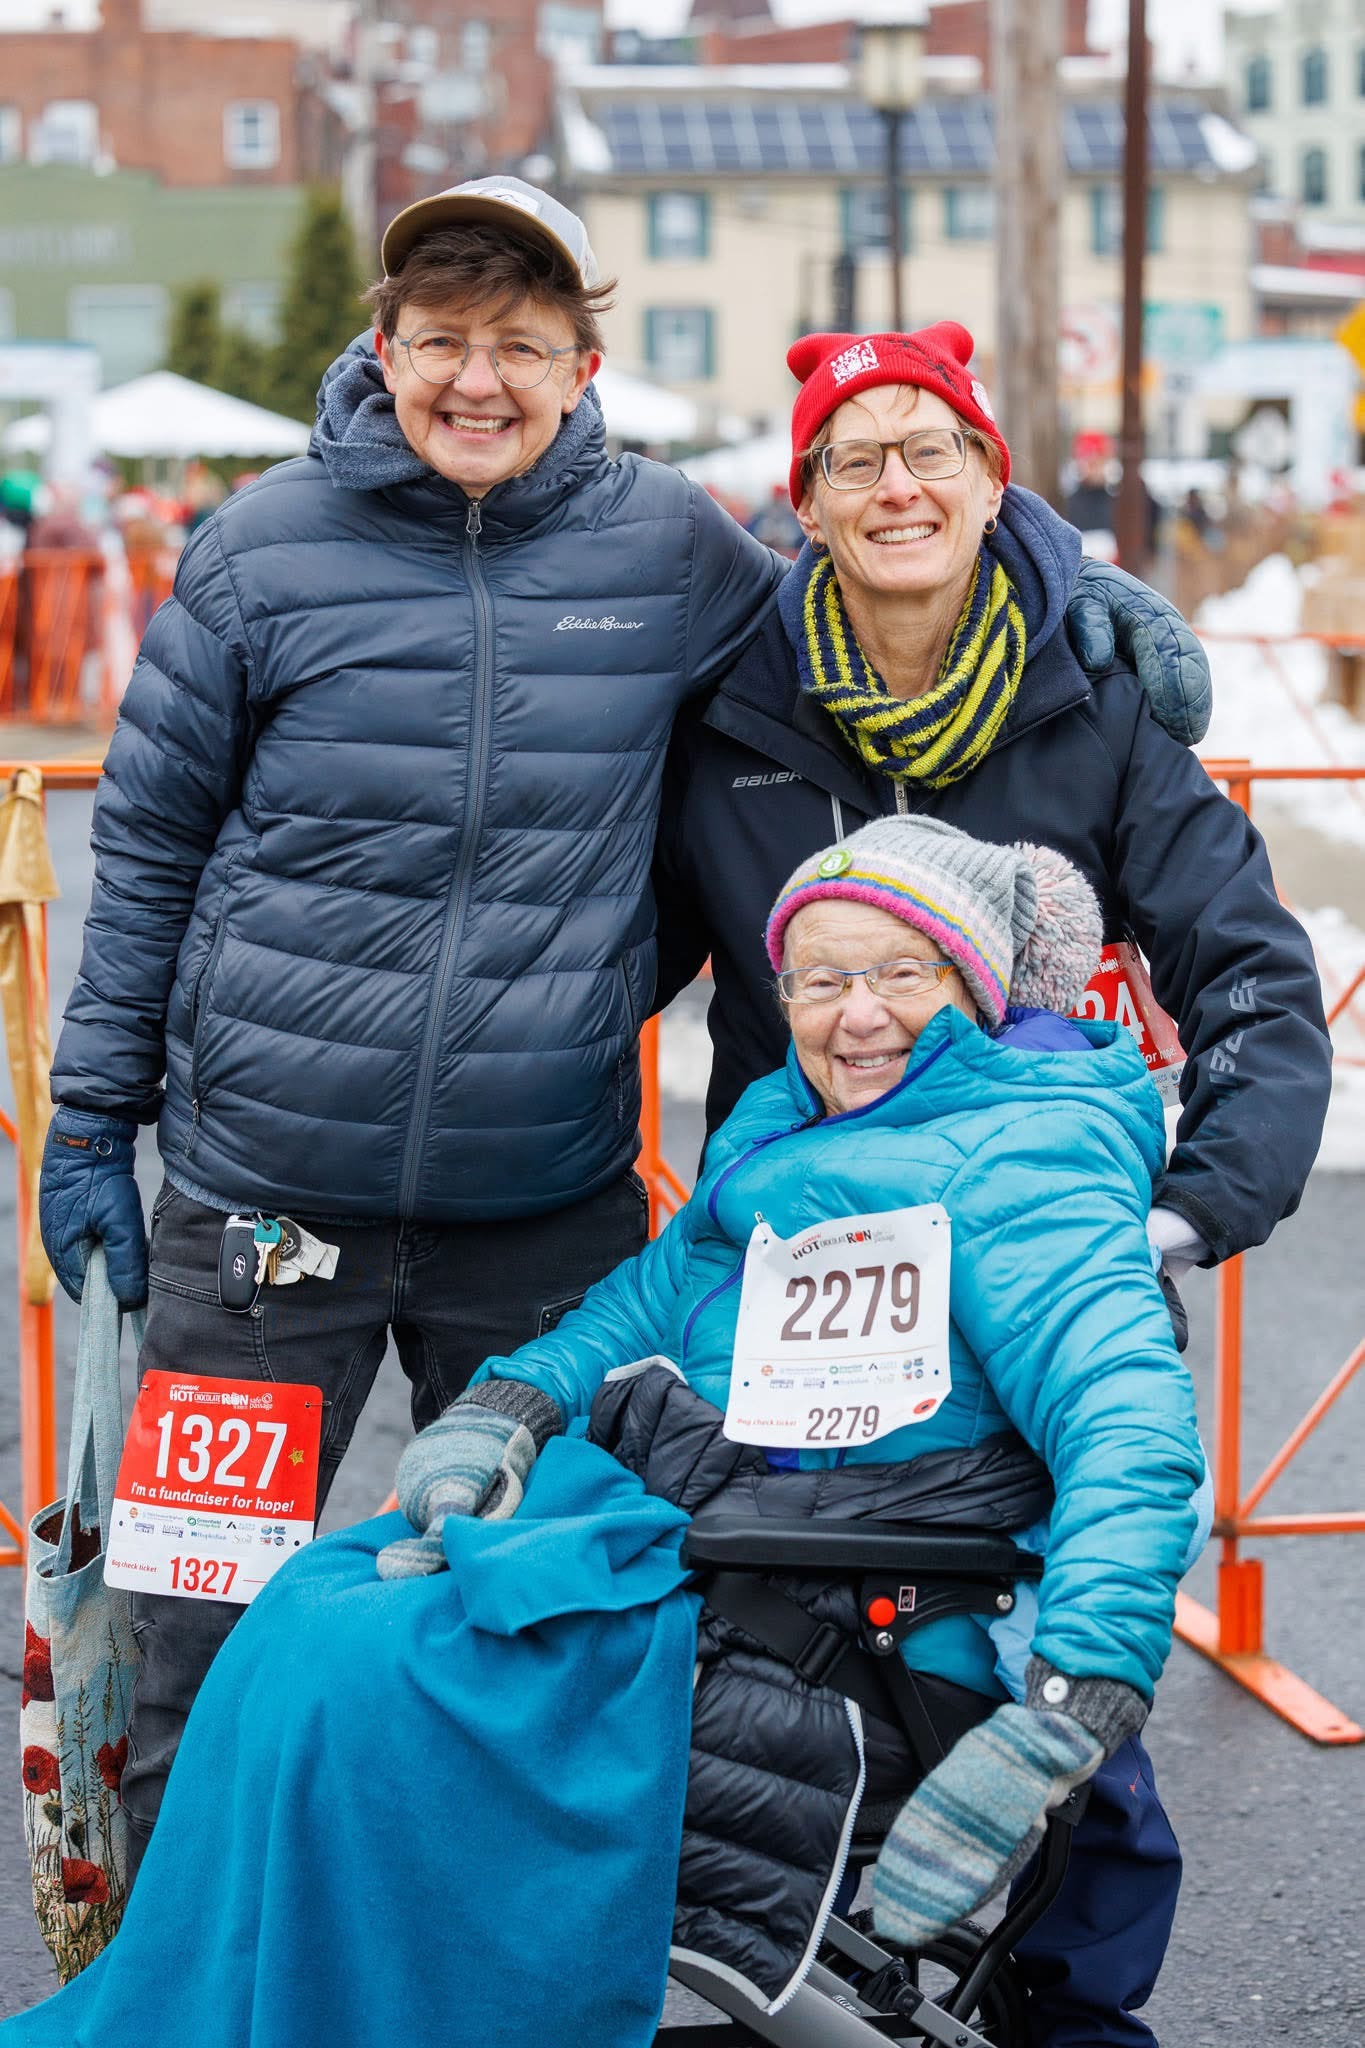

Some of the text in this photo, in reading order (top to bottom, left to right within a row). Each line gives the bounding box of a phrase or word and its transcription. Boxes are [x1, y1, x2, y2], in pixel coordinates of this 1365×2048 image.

[552, 616, 644, 631] Eddie Bauer
[792, 1240, 820, 1260] HOT
[846, 1229, 872, 1244] RUN
[780, 1261, 921, 1341] 2279
[169, 1389, 195, 1402] HOT
[221, 1392, 249, 1406] RUN
[805, 1405, 880, 1441] 2279
[156, 1410, 288, 1490] 1327
[131, 1482, 295, 1514] I'm a fundraiser for hope!
[170, 1556, 239, 1595] 1327
